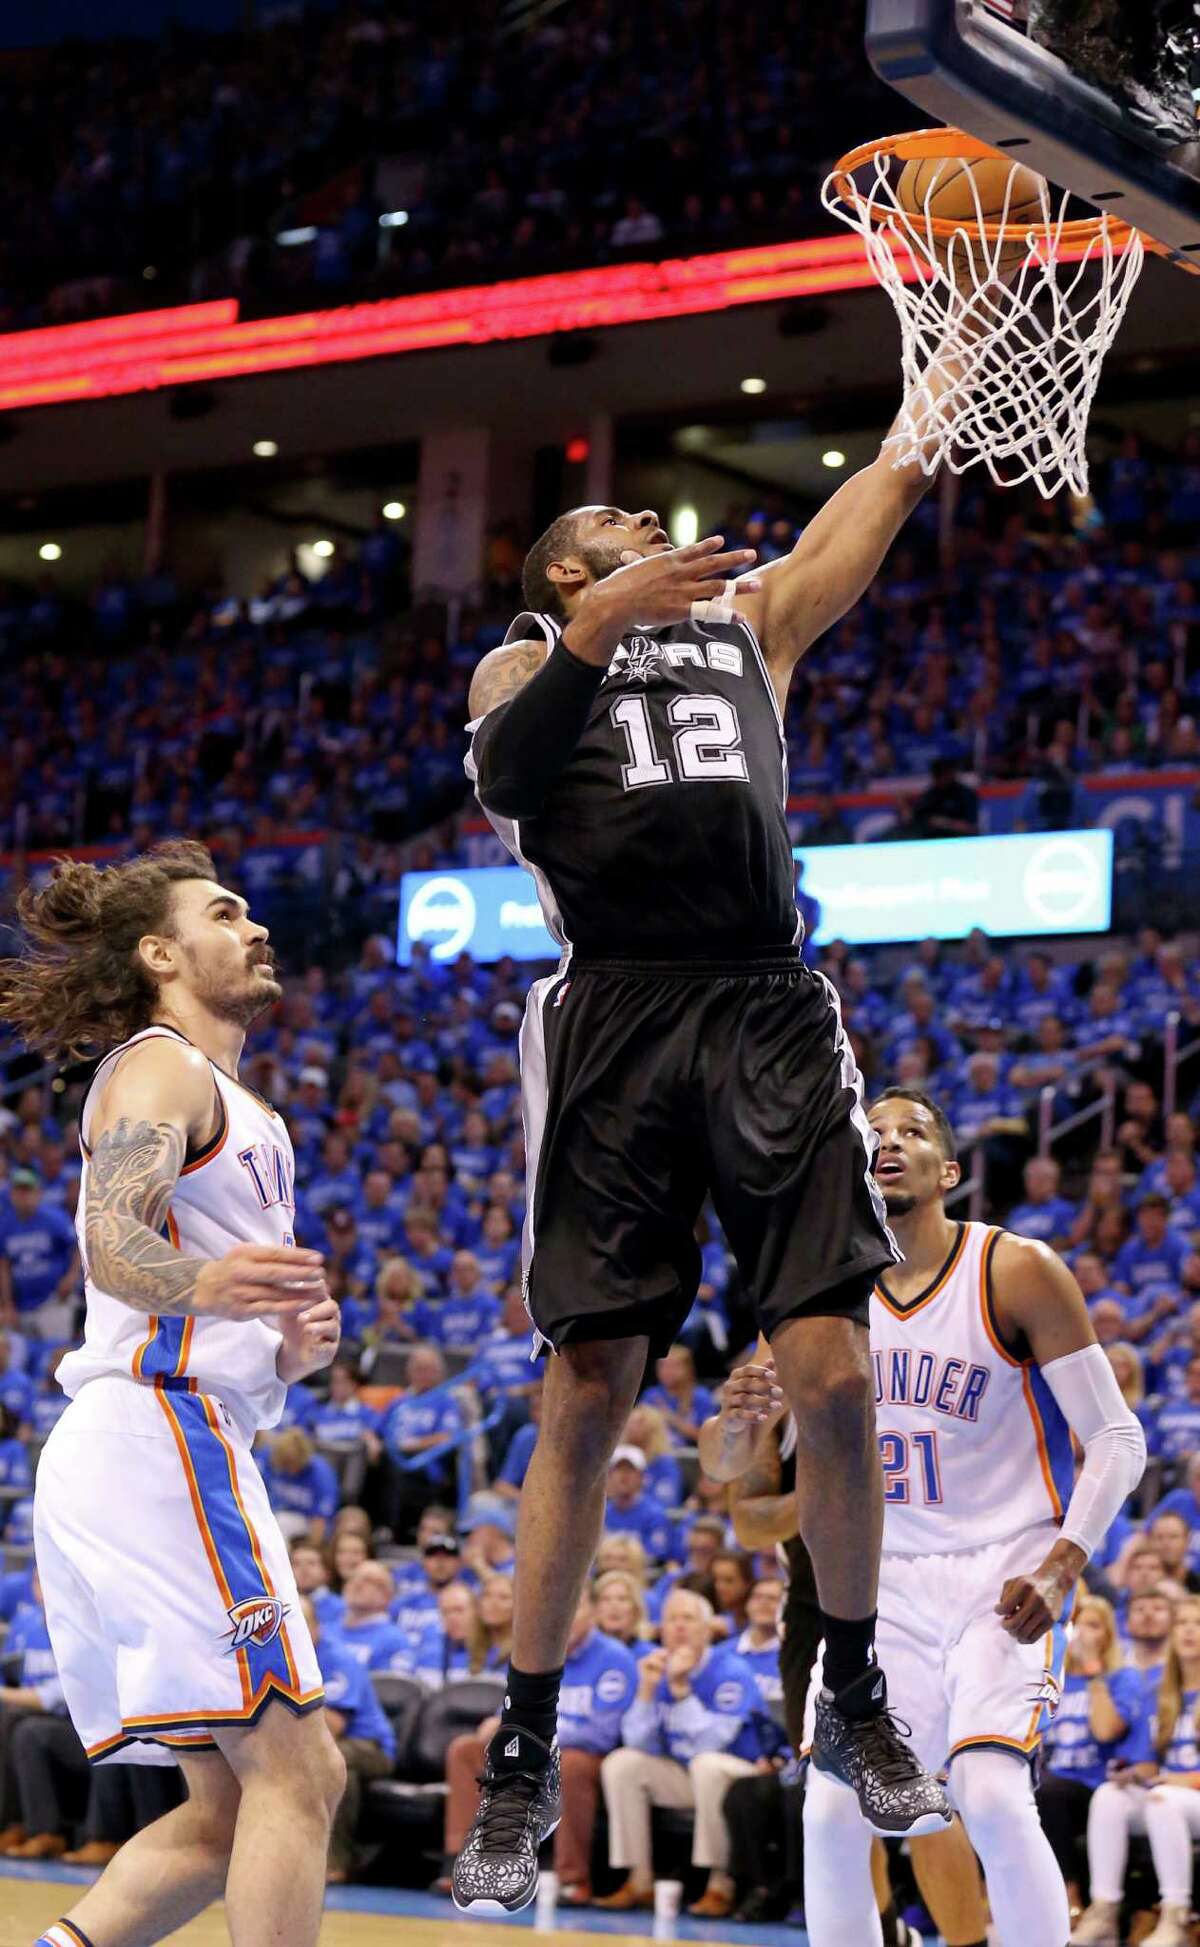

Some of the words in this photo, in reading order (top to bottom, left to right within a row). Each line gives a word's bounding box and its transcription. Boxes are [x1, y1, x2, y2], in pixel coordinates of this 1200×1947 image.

[609, 693, 750, 792] 12
[869, 1348, 991, 1422] UNDER
[878, 1430, 943, 1505] 21
[232, 1603, 275, 1646] OKC
